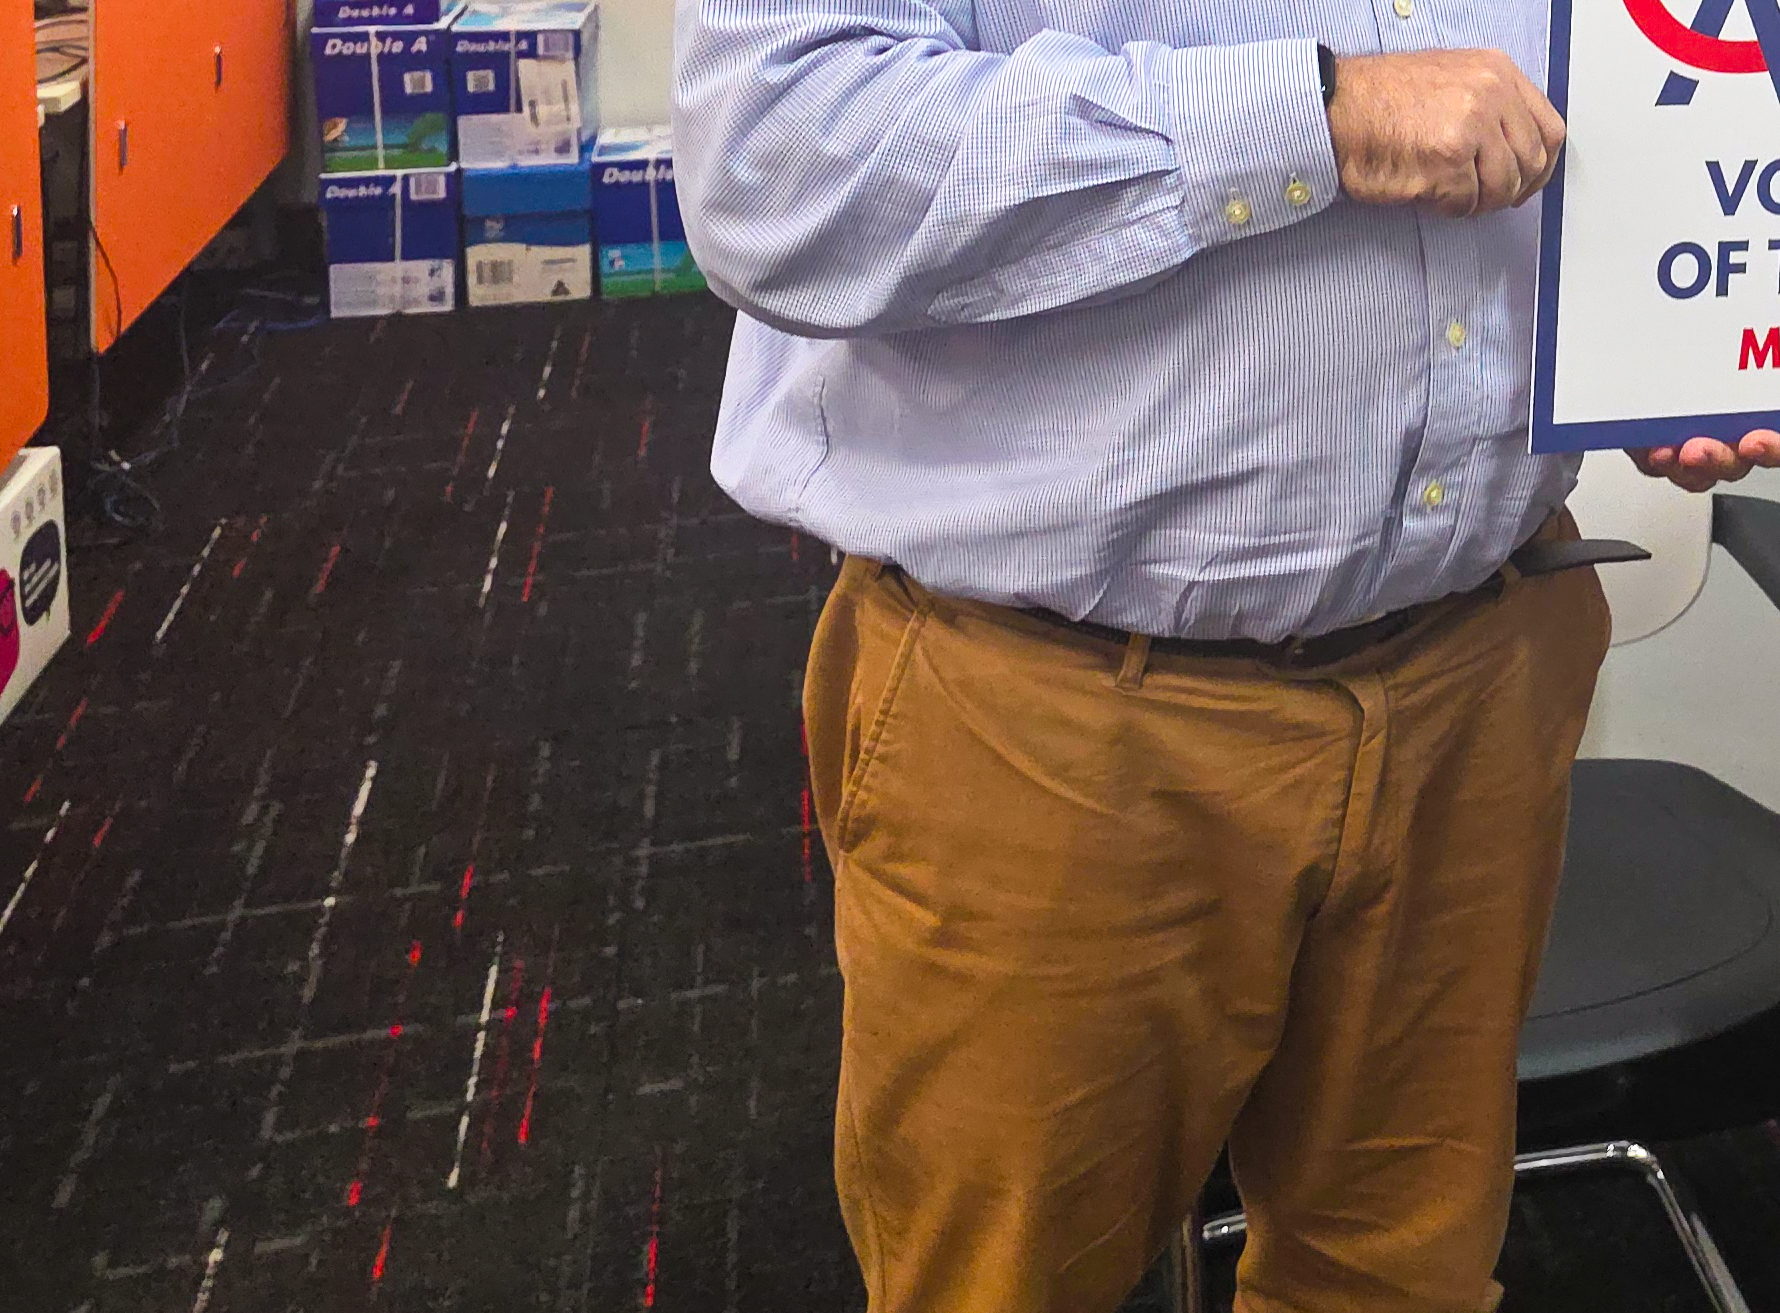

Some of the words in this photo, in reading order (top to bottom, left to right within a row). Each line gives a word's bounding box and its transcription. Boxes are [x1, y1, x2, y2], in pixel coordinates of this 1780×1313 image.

[338, 4, 398, 19] Double
[402, 3, 415, 16] A
[324, 37, 404, 56] Double
[410, 35, 428, 54] A
[1657, 240, 1749, 300] OF
